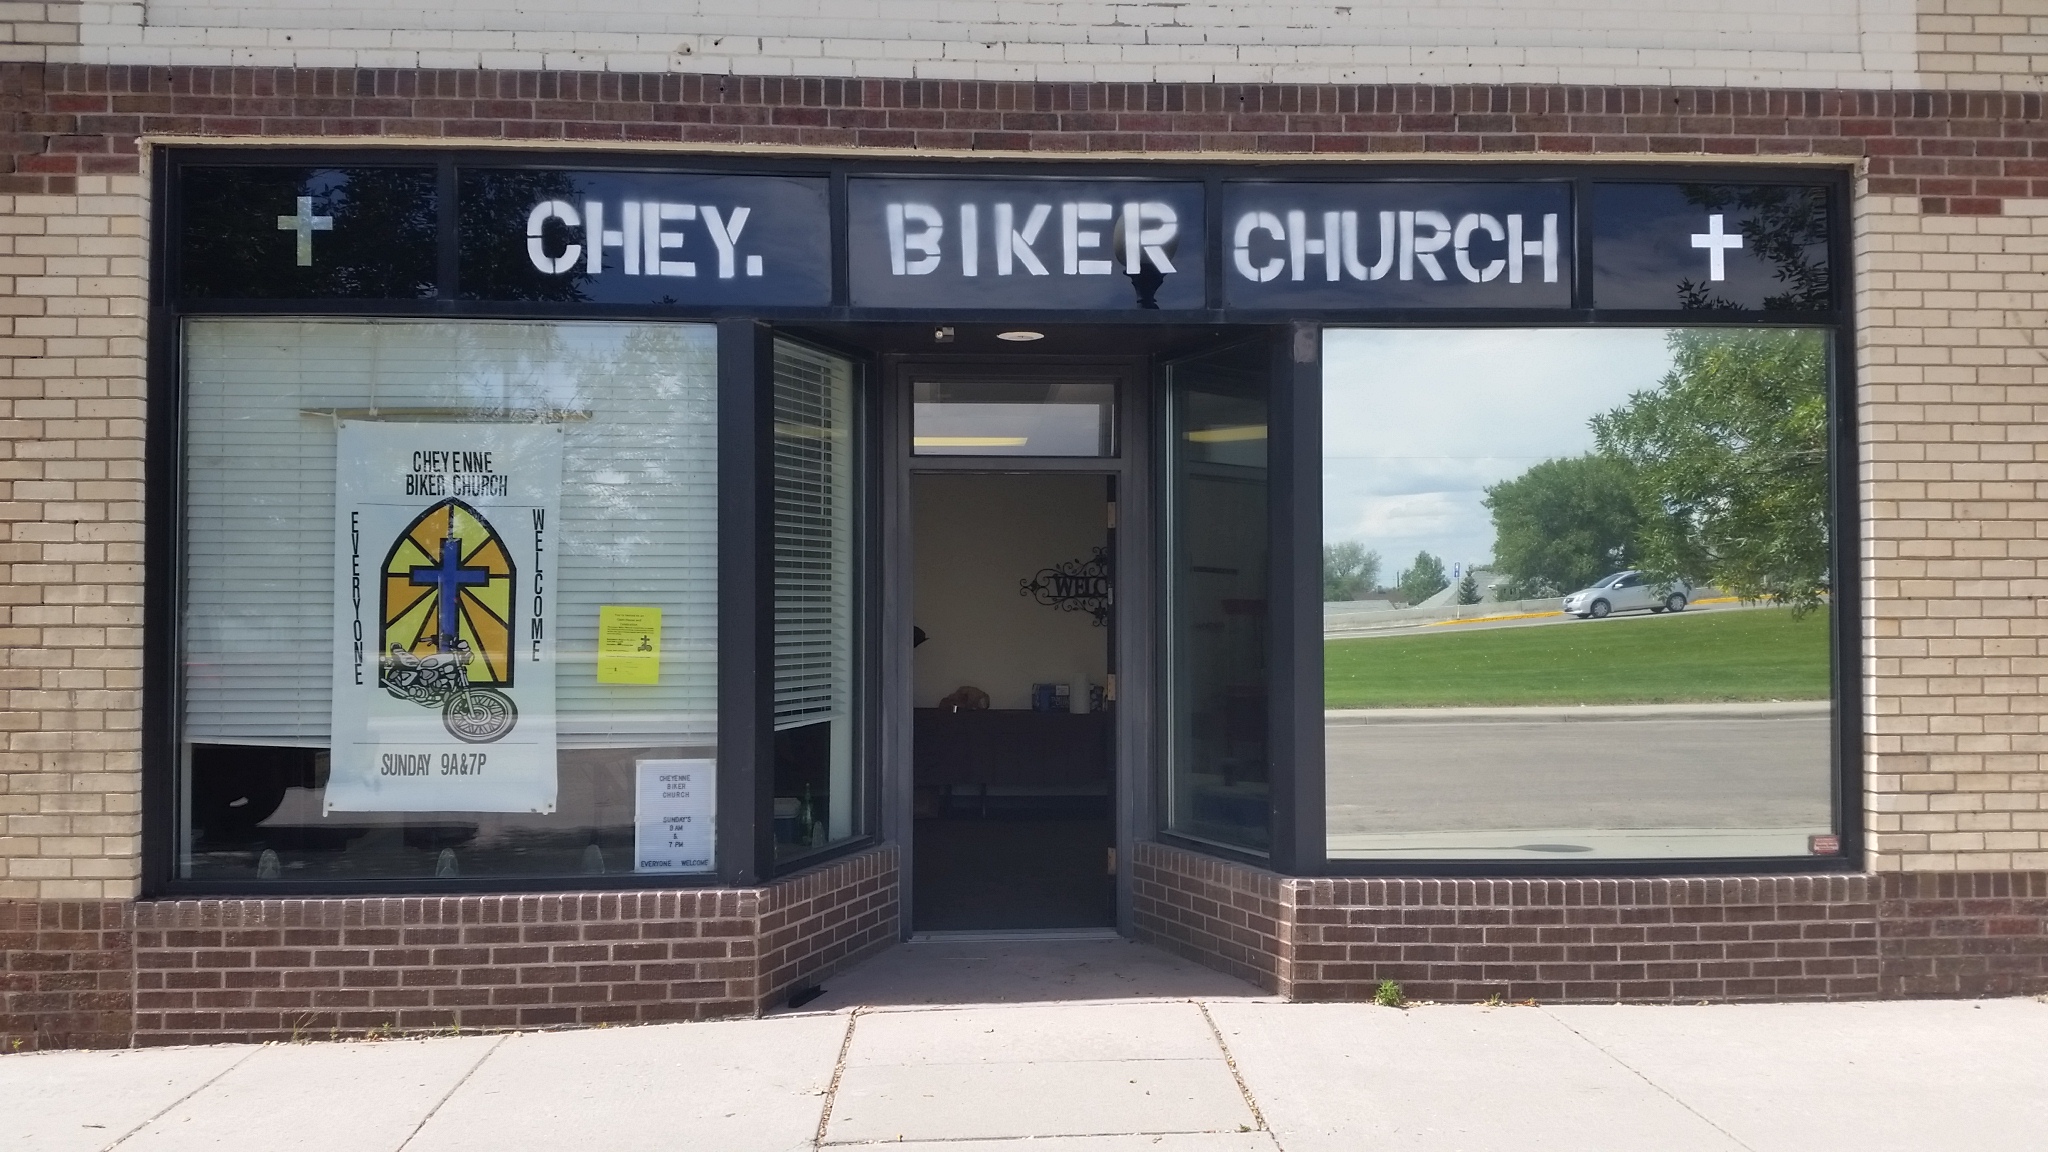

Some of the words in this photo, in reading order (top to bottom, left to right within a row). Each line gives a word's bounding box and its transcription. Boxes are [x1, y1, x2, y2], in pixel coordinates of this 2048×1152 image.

[526, 200, 763, 279] CHEY.
[885, 201, 1179, 277] BIKER
[1233, 210, 1559, 284] CHURCH
[413, 450, 493, 473] CHEYENNE
[406, 474, 446, 496] BIKER
[452, 474, 508, 497] CHURCH
[531, 508, 544, 662] WELCOME
[1055, 576, 1107, 598] WELC
[351, 511, 364, 685] EVERYONE
[380, 753, 431, 776] SUNDAY
[440, 753, 487, 776] 9A&7P
